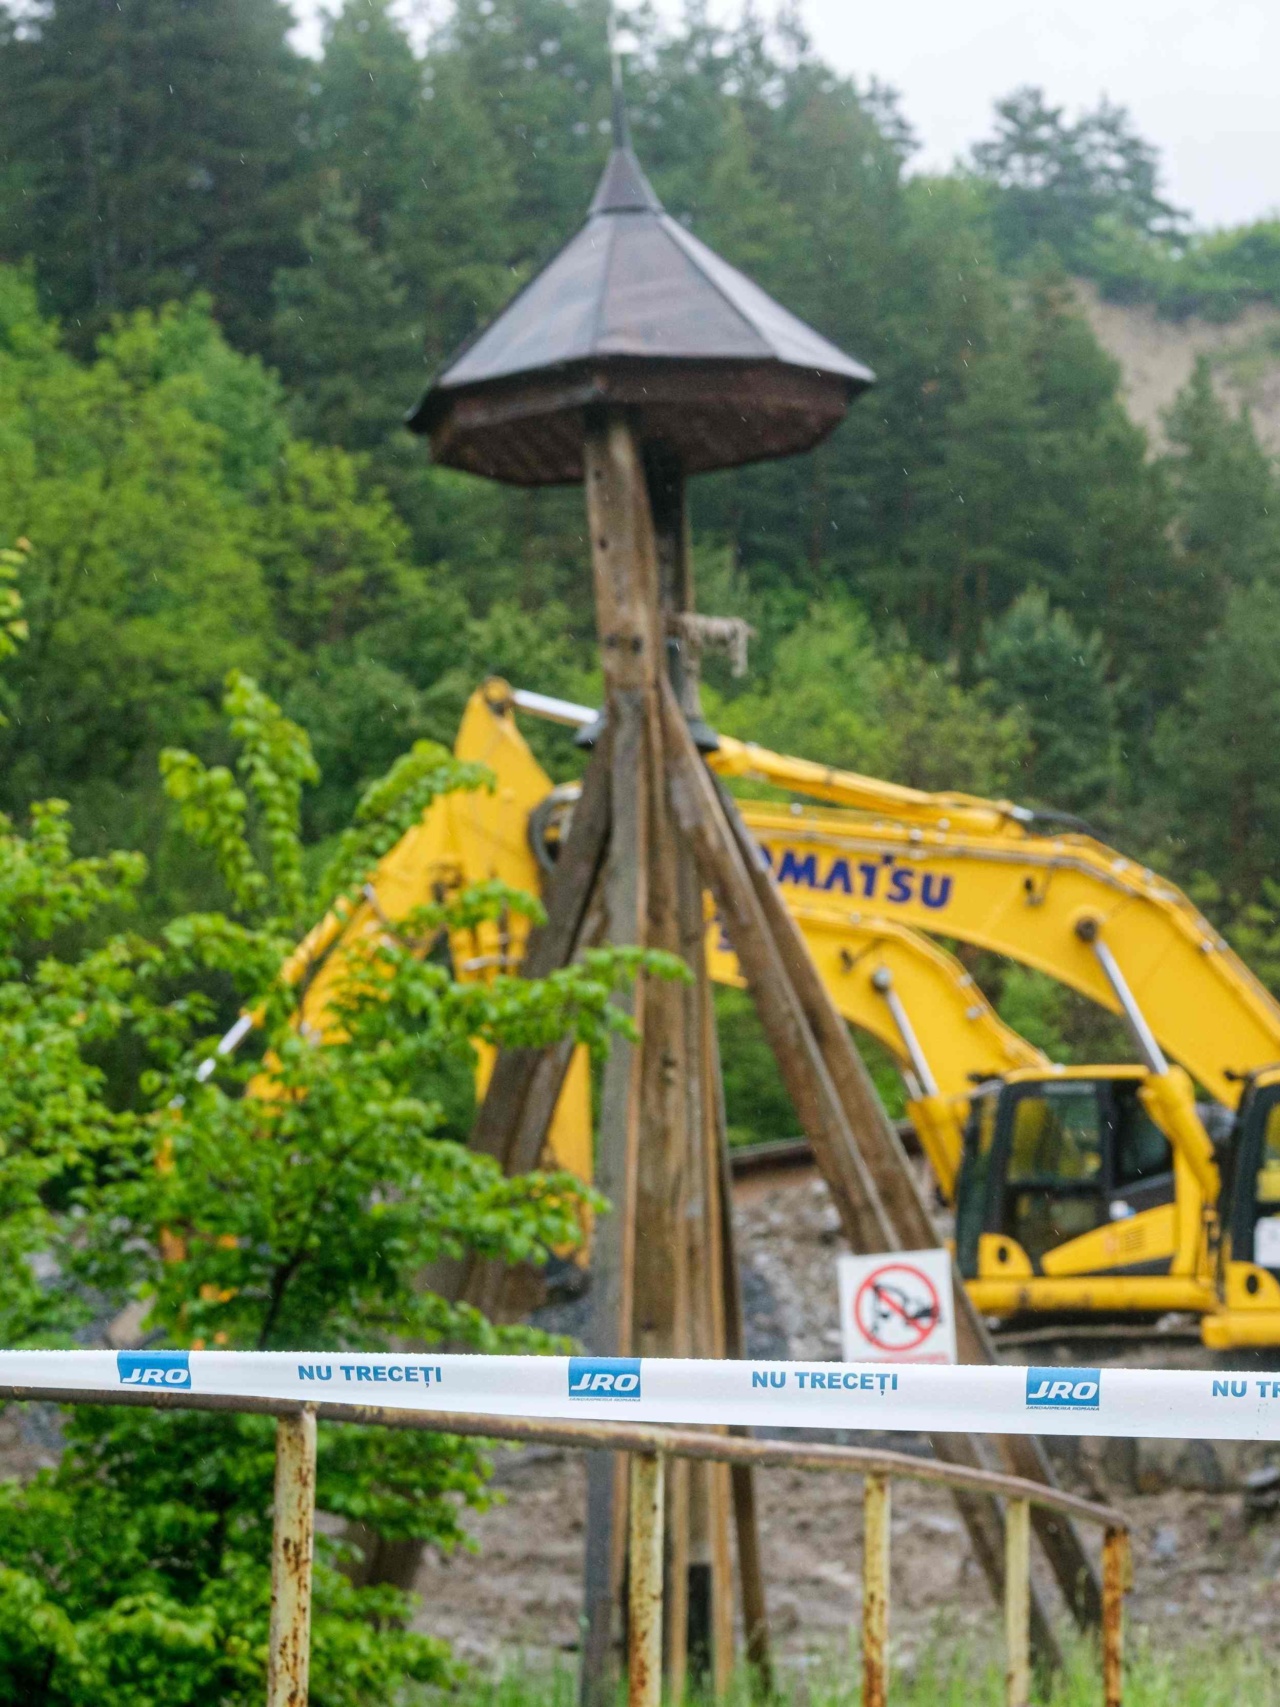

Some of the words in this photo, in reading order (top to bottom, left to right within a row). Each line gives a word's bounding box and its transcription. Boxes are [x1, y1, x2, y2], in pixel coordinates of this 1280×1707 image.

[763, 846, 952, 908] MATSU
[122, 1368, 188, 1383] JRO
[298, 1365, 332, 1381] NU
[340, 1365, 442, 1387] TRECEȚI
[571, 1373, 638, 1391] JRO
[752, 1372, 786, 1389] NU
[796, 1372, 898, 1396] TRECEȚI
[1028, 1381, 1098, 1400] JRO
[1212, 1381, 1247, 1397] NU
